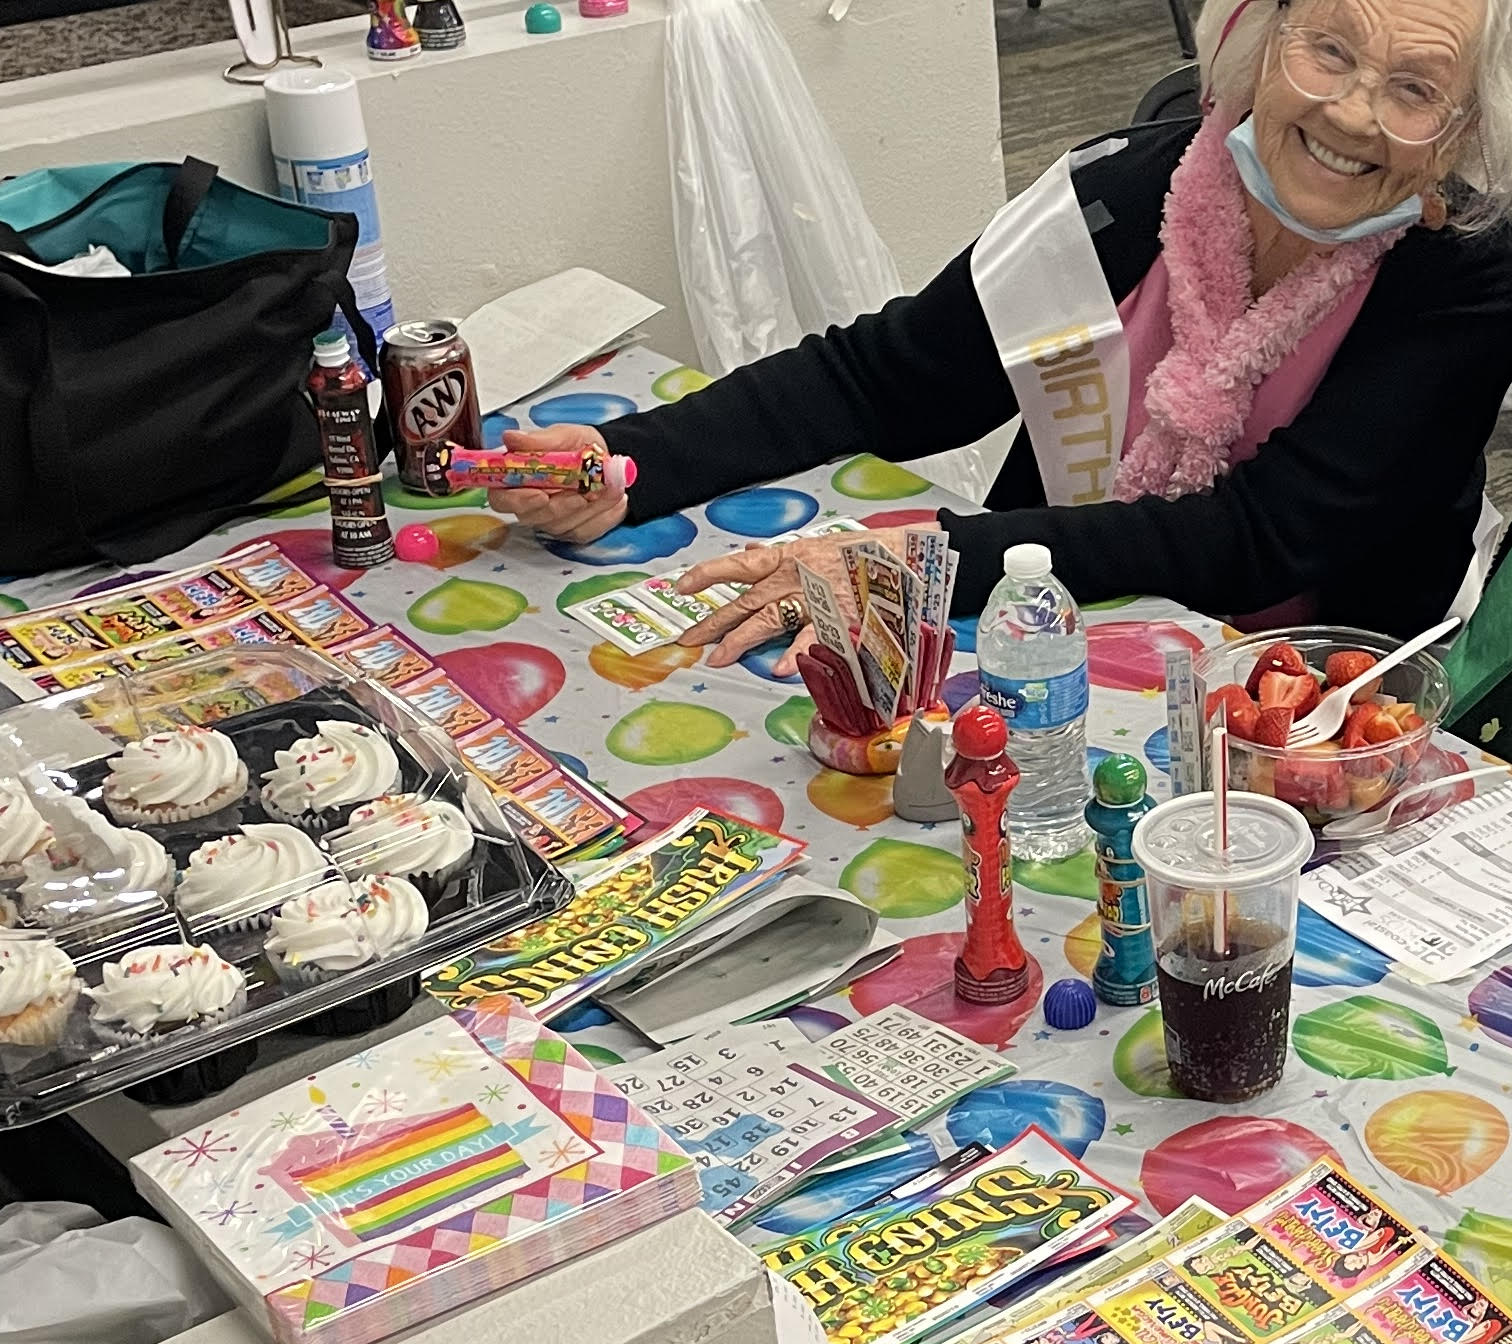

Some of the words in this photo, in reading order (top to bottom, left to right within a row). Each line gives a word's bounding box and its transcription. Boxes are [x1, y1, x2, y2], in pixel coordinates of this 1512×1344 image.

[632, 821, 760, 929] IRISH
[451, 924, 648, 1008] COINS
[876, 1017, 902, 1031] 71
[853, 1028, 879, 1042] 75
[898, 1027, 922, 1041] 49
[718, 1047, 737, 1060] 3
[830, 1038, 857, 1054] 70
[875, 1038, 901, 1053] 48
[922, 1038, 948, 1053] 31
[673, 1054, 702, 1073] 15
[852, 1049, 879, 1065] 56
[899, 1050, 925, 1065] 36
[944, 1050, 973, 1066] 23
[746, 1066, 765, 1077] 6
[922, 1062, 950, 1078] 30
[974, 1064, 992, 1076] 1
[615, 1076, 644, 1094] 24
[656, 1074, 686, 1093] 27
[708, 1075, 724, 1087] 4
[769, 1076, 799, 1096] 14
[853, 1073, 879, 1089] 40
[900, 1074, 928, 1090] 18
[949, 1077, 970, 1088] 7
[682, 1091, 714, 1111] 28
[737, 1089, 756, 1103] 2
[808, 1096, 825, 1108] 7
[878, 1087, 906, 1102] 19
[927, 1088, 946, 1100] 5
[767, 1108, 786, 1120] 9
[829, 1105, 858, 1123] 13
[900, 1099, 929, 1116] 15
[711, 1107, 741, 1126] 16
[741, 1123, 770, 1144] 18
[790, 1118, 819, 1134] 10
[705, 1136, 733, 1154] 17
[771, 1137, 800, 1157] 19
[379, 1158, 436, 1186] YOUR
[440, 1133, 493, 1164] DAY!
[733, 1155, 763, 1173] 22
[711, 1176, 741, 1198] 45
[850, 1169, 1108, 1272] COINS
[1295, 1198, 1365, 1250] BETTY
[1228, 1263, 1303, 1317] BETTY
[1210, 1270, 1287, 1331] JUNGLE
[1144, 1298, 1203, 1341] BETTY
[1394, 1285, 1472, 1344] BETTY
